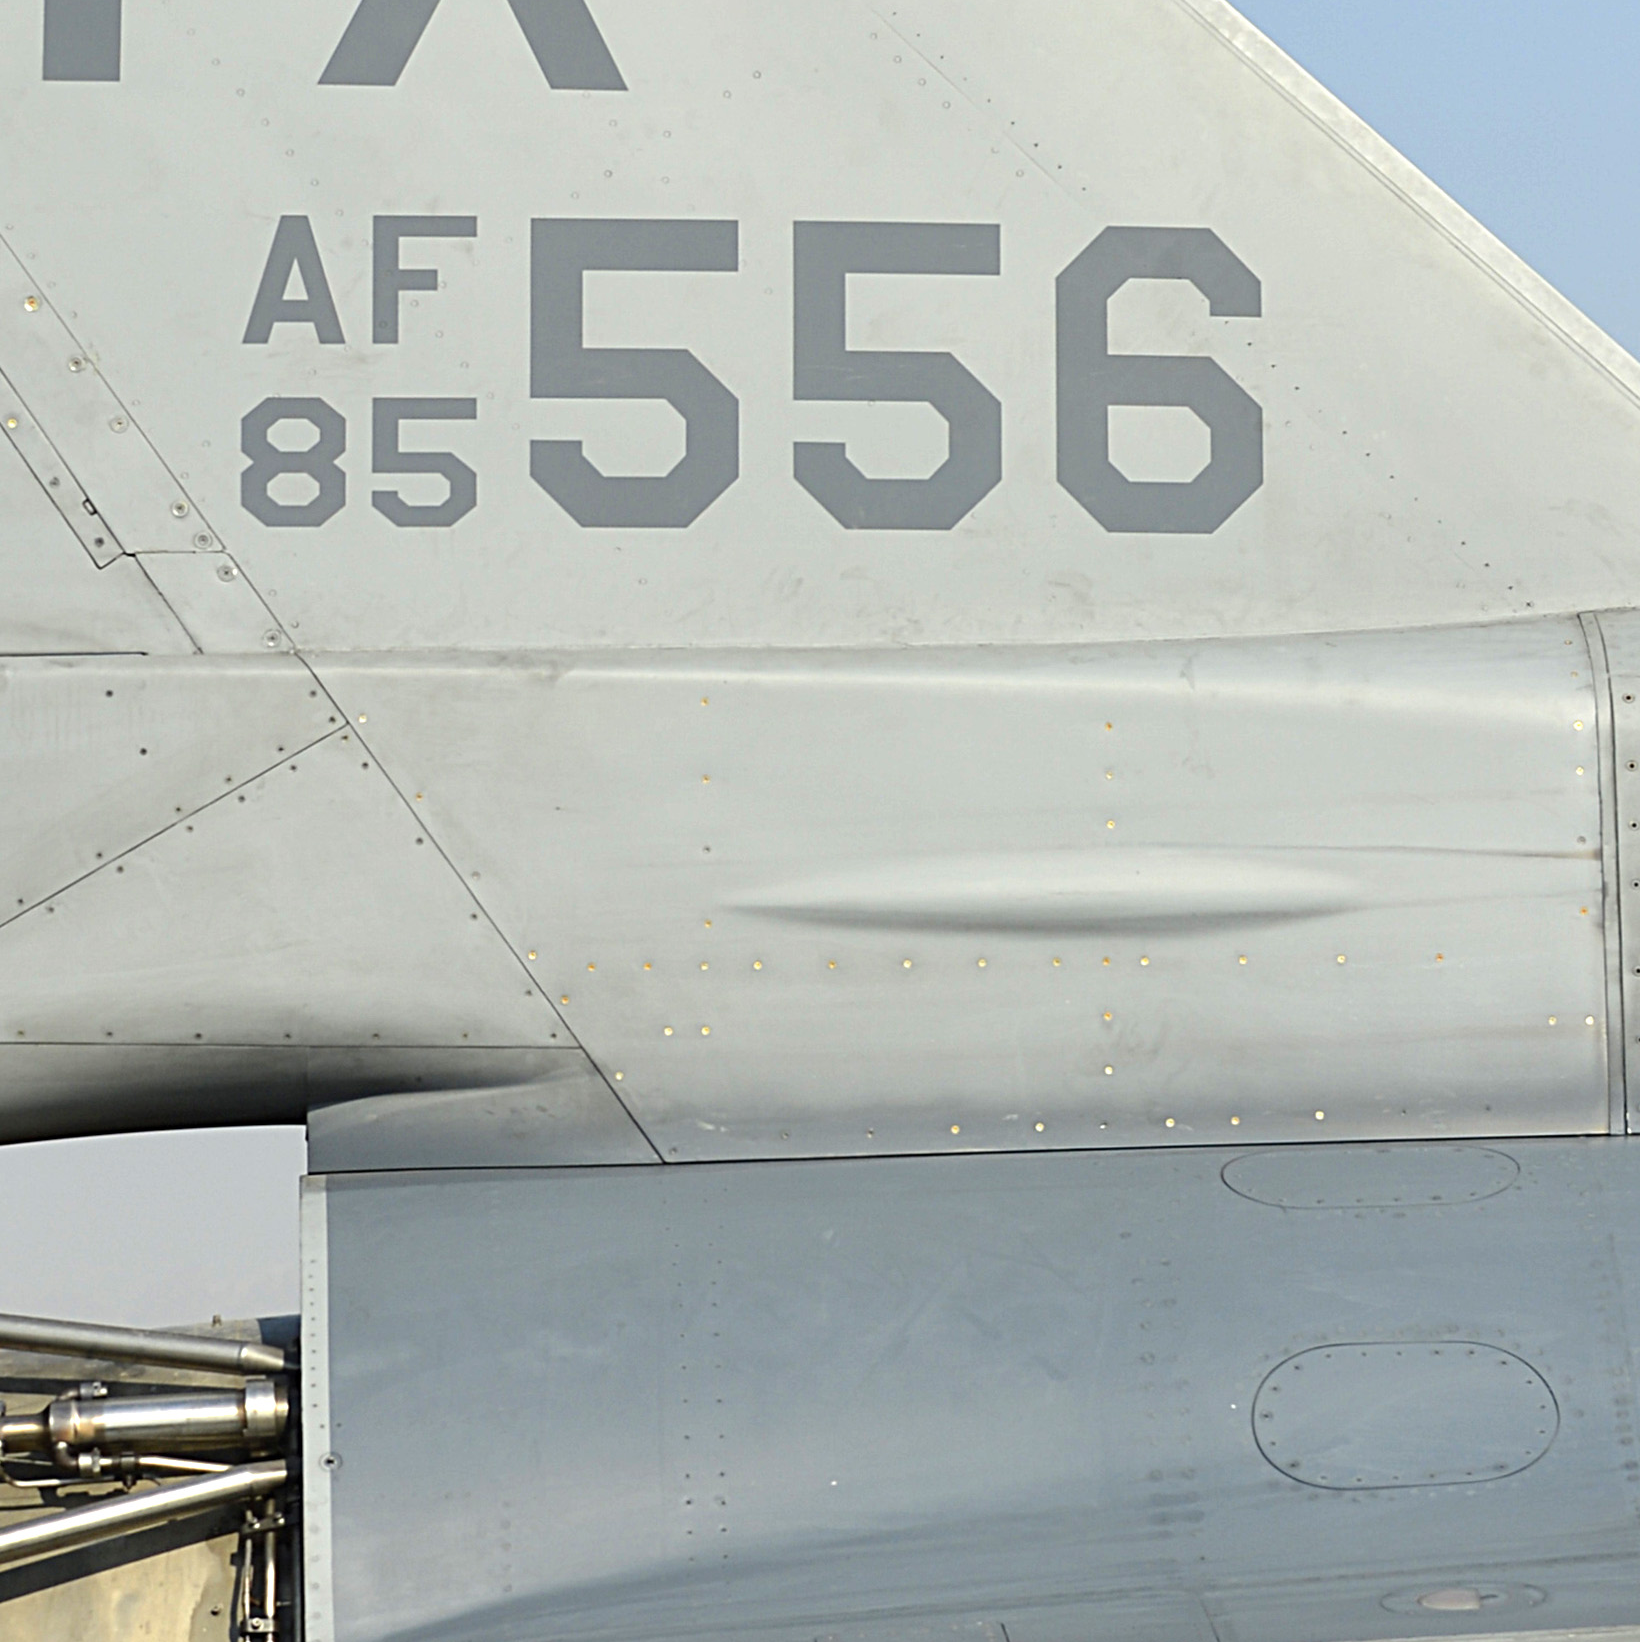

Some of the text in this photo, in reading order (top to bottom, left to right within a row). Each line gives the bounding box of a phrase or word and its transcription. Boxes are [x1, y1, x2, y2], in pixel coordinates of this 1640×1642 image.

[242, 215, 478, 345] AF
[529, 217, 1265, 535] 556
[240, 397, 478, 528] 85
